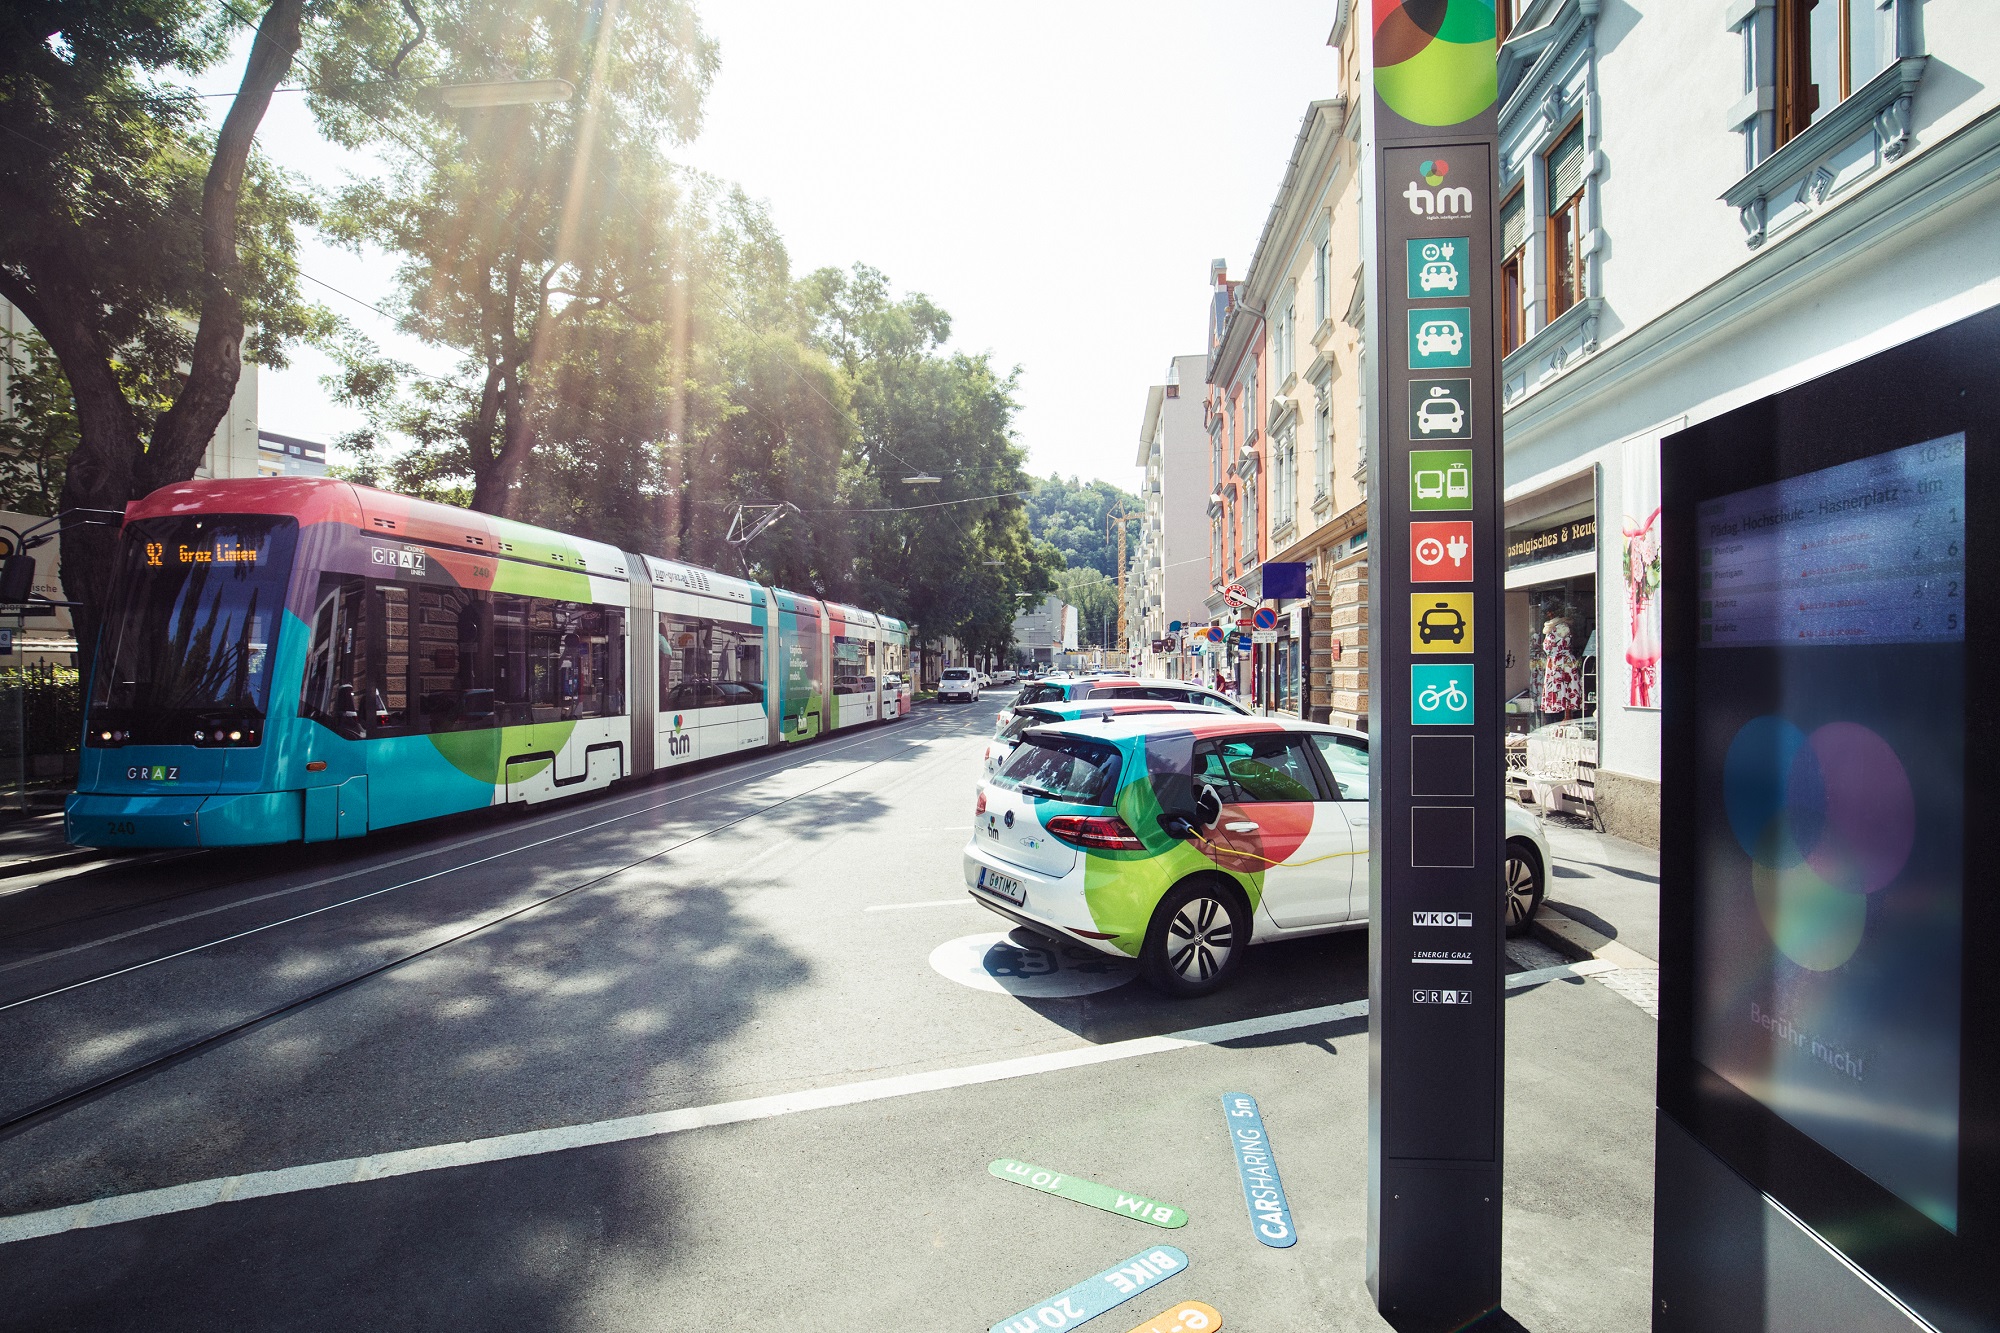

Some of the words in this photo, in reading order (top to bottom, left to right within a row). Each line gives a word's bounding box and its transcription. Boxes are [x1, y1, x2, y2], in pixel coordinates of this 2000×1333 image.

[1403, 181, 1472, 215] tim
[1742, 507, 1804, 532] Hochschule
[1818, 487, 1899, 516] Hasnerplatz
[1918, 477, 1944, 495] tim
[146, 542, 163, 566] 92
[179, 544, 212, 563] Graz
[216, 543, 257, 562] Linien
[372, 547, 425, 570] GRAZ
[403, 544, 425, 554] HOLDING
[473, 565, 490, 578] 240
[1948, 581, 1959, 598] 2
[1948, 613, 1958, 630] 5
[668, 731, 690, 756] tim
[127, 767, 178, 780] GRAZ
[108, 821, 135, 835] 240
[1413, 912, 1456, 925] WKO
[1418, 951, 1450, 959] ENERGIE
[1413, 990, 1471, 1004] GRAZ
[1751, 1002, 1807, 1047] Berühr
[1811, 1041, 1863, 1081] mich!
[1237, 1129, 1288, 1238] CARSHARING
[1114, 1195, 1173, 1223] BIM
[1104, 1250, 1179, 1294] BIKE
